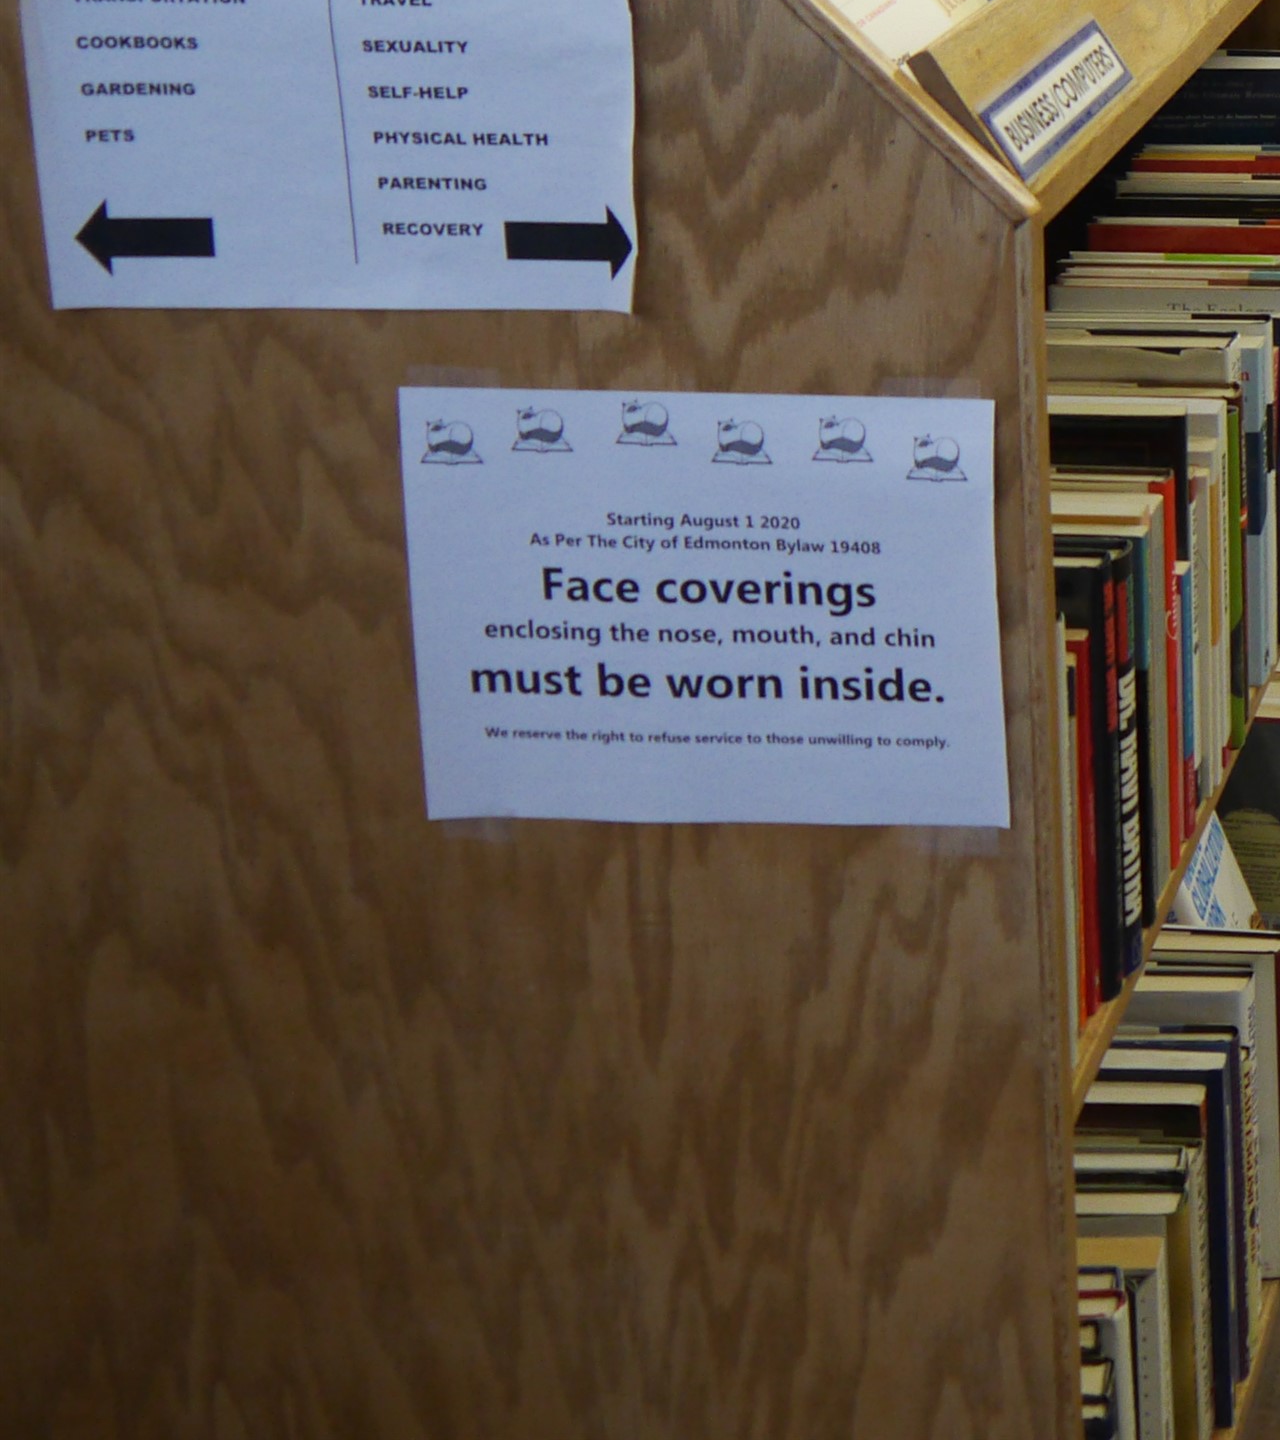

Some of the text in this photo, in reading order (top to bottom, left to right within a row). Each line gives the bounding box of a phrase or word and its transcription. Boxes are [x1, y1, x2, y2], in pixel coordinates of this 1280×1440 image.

[76, 35, 469, 54] COOKBOOKS SEXUALITY
[81, 82, 469, 101] GARDENING SELF-HELP
[1003, 44, 1115, 152] BUSINESS/COMPUTERS
[85, 129, 549, 147] PETS PHYSICAL HEALTH
[378, 177, 487, 192] PARENTING
[382, 222, 484, 238] RECOVERY
[606, 511, 801, 532] Starting August 1 2020
[530, 533, 881, 555] As Per The City of Edmonton Bylaw 19408
[541, 566, 877, 617] Face coverings
[484, 620, 936, 649] enclosing the nose, mouth, and chin
[470, 662, 946, 704] must be worn inside.
[485, 726, 951, 751] We reserve the right to refuse service to those unwilling to comply.
[1120, 814, 1143, 928] BATRA
